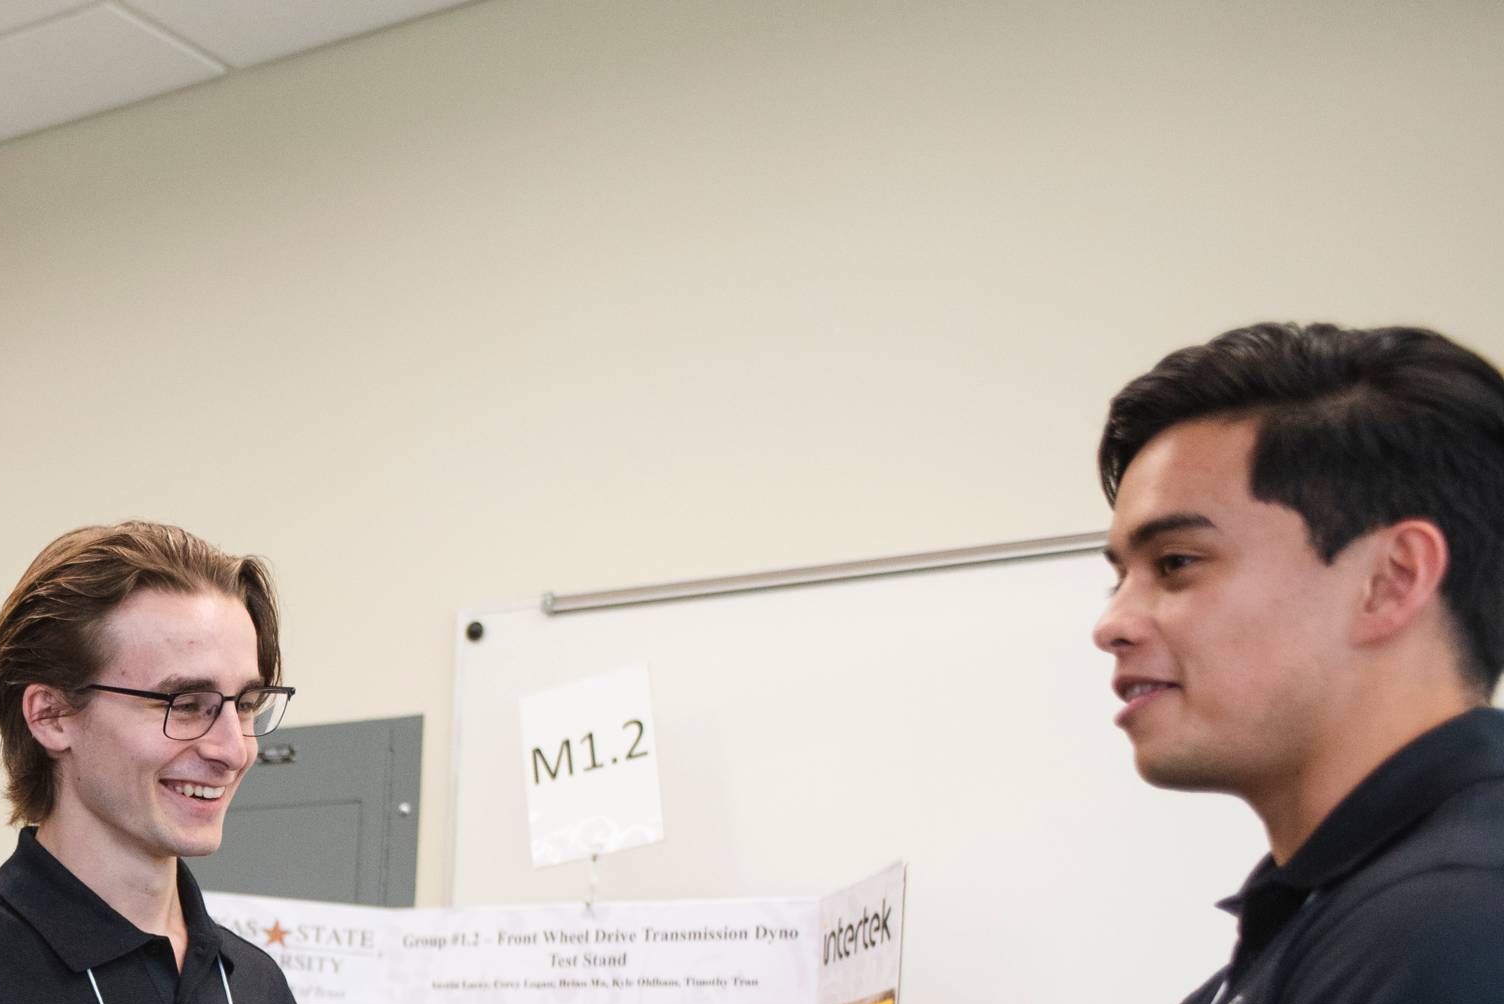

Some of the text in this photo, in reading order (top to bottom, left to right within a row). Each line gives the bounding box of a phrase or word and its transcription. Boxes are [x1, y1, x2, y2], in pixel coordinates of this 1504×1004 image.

[531, 718, 649, 785] M1.2
[295, 923, 375, 949] STATE
[402, 924, 799, 951] Group #1.2 Front Wheel Drive Transmission Dyno
[822, 898, 892, 967] intertek
[279, 953, 343, 974] RSITY
[551, 951, 628, 968] Test Stand
